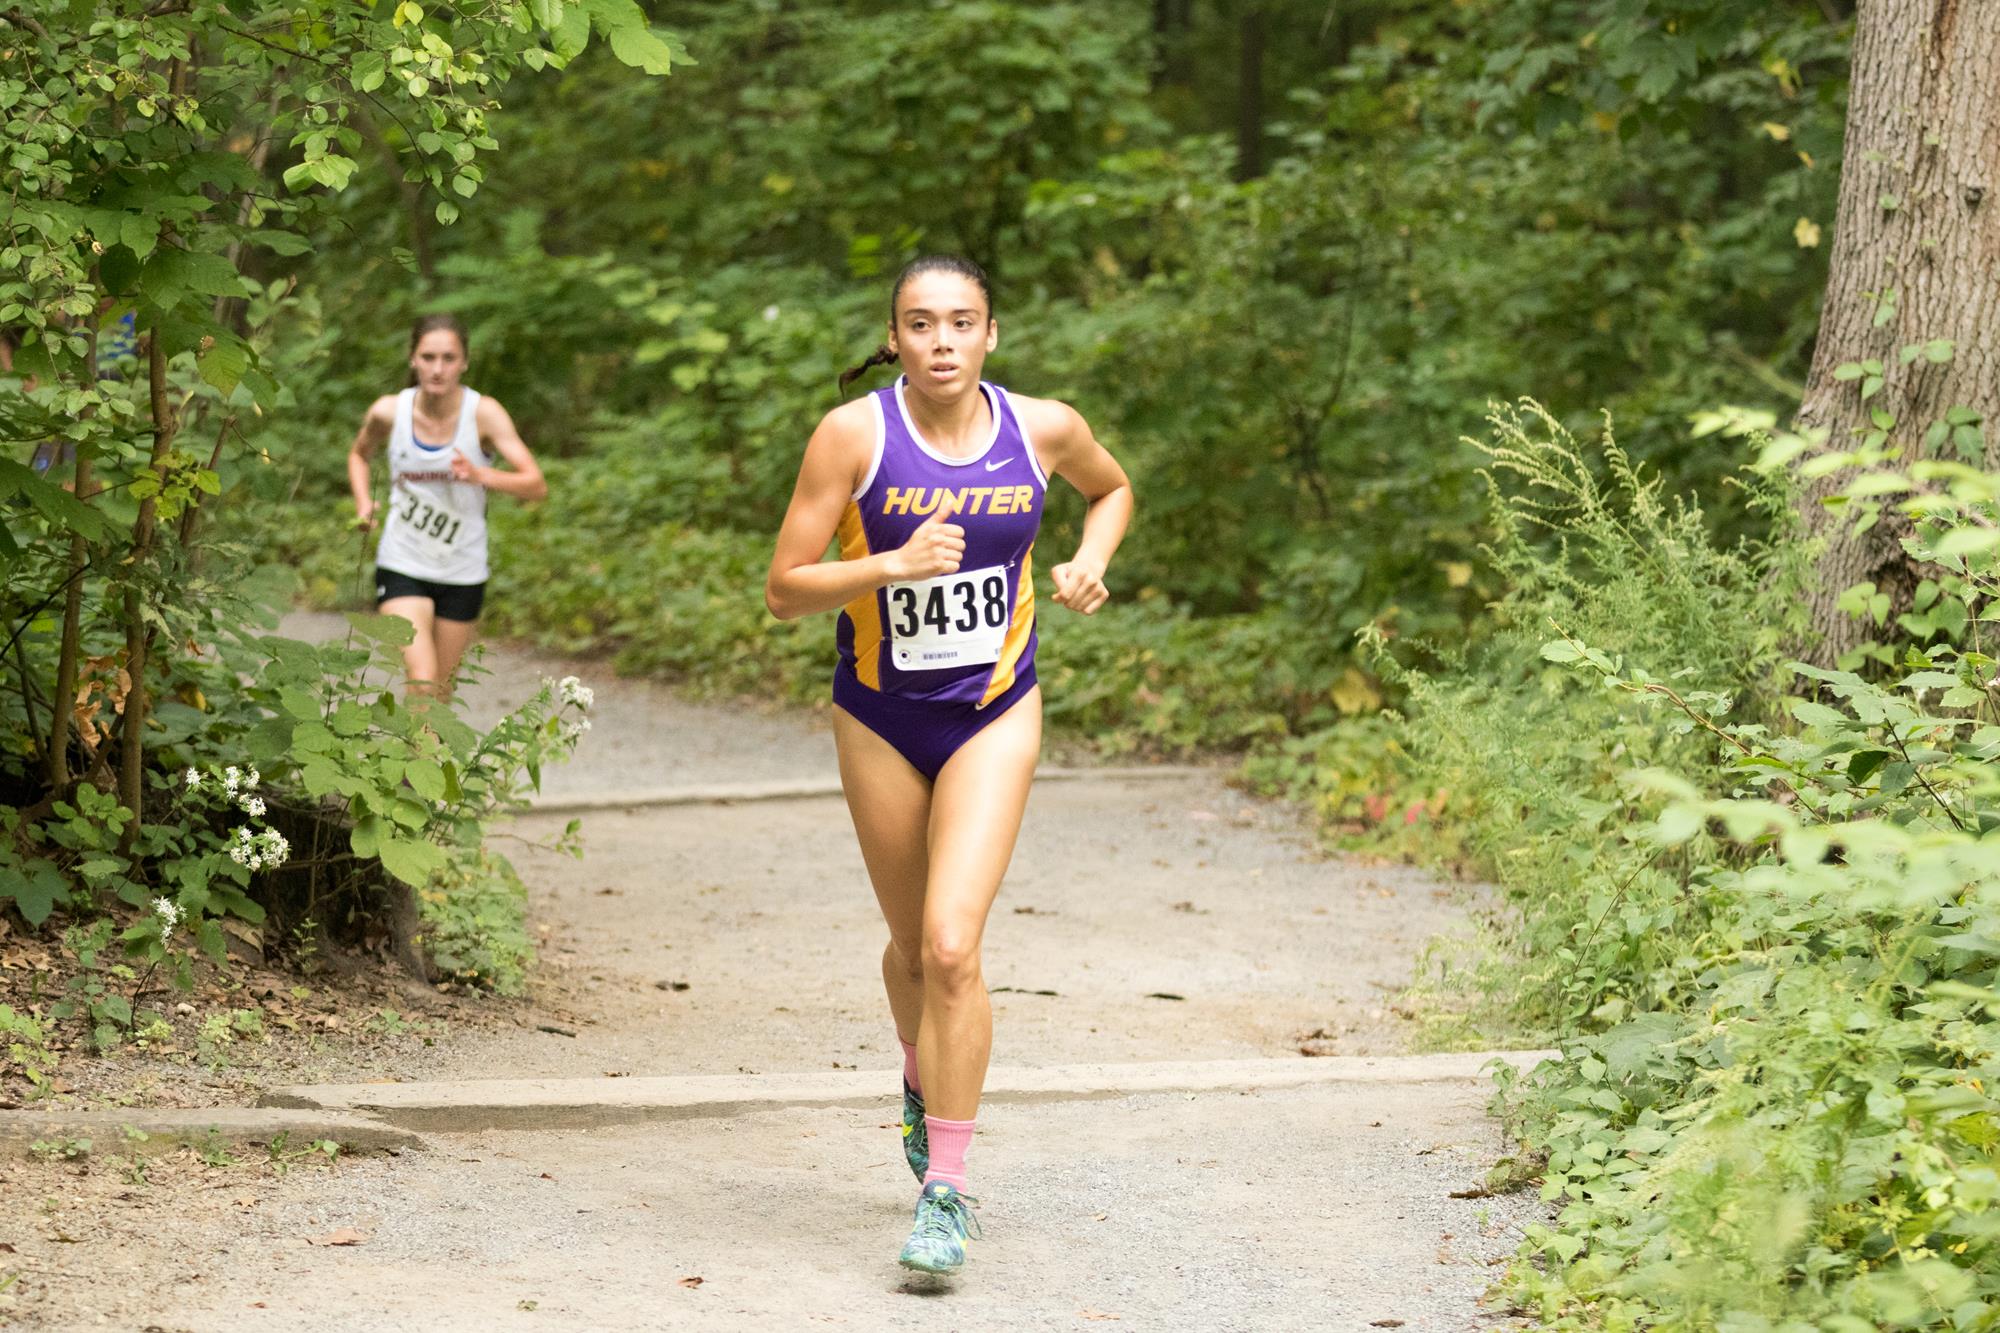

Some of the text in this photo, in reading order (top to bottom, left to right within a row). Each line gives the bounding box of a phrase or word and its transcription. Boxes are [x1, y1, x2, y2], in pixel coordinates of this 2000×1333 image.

[401, 495, 461, 544] 3391
[882, 485, 1033, 516] HUNTER
[892, 575, 1006, 638] 3438
